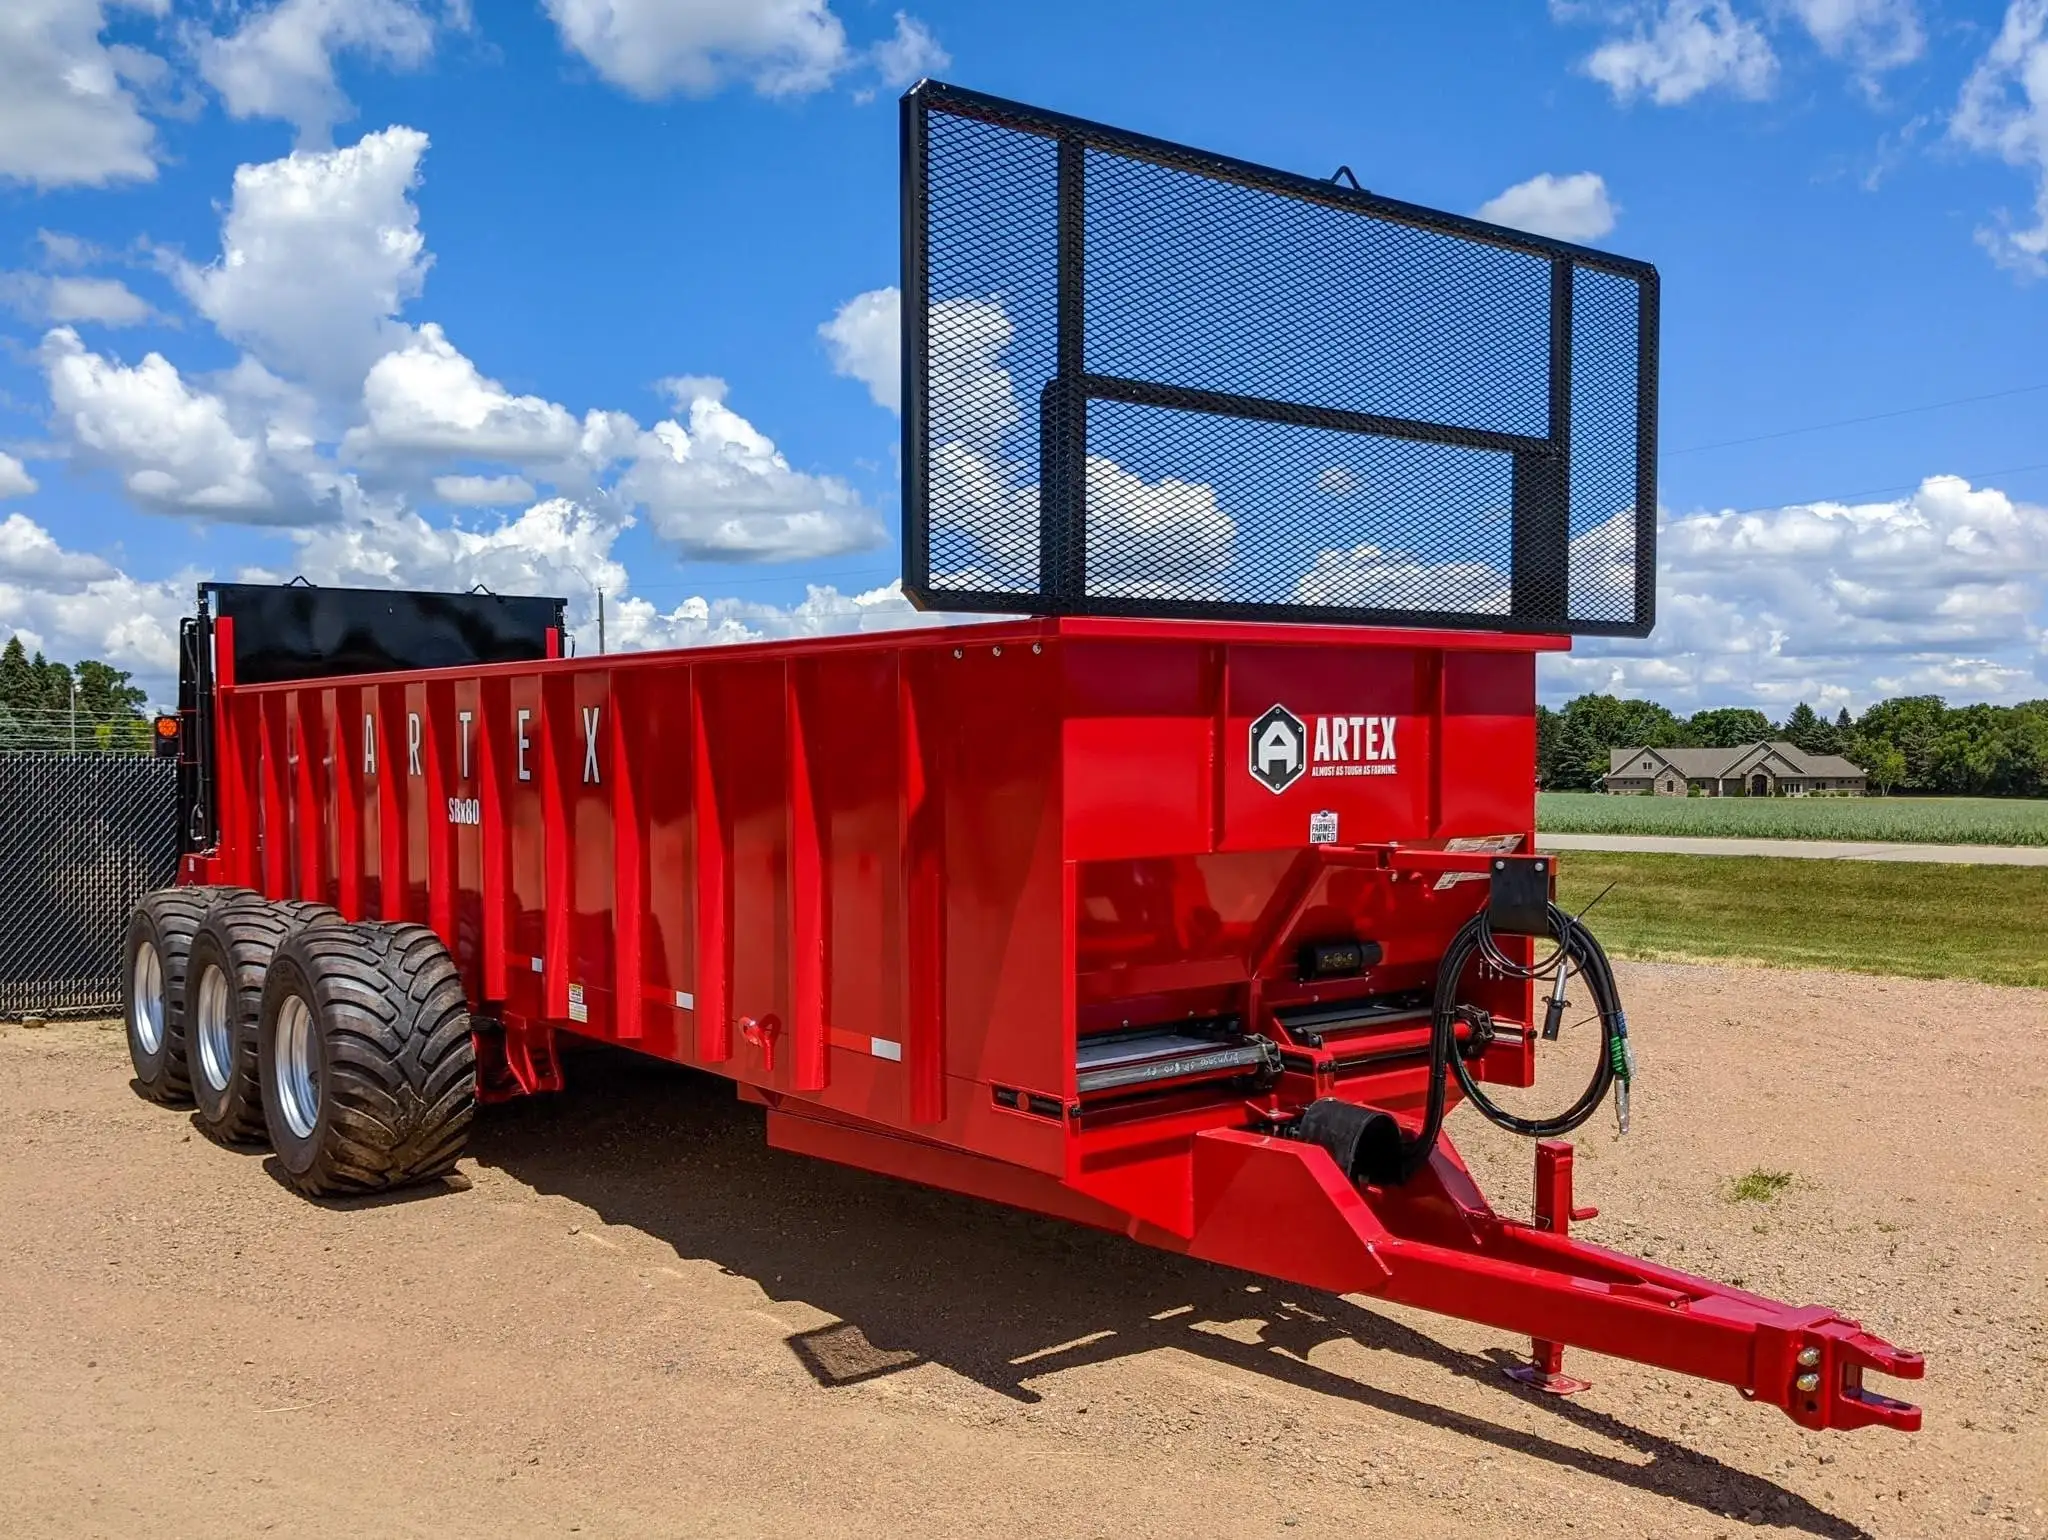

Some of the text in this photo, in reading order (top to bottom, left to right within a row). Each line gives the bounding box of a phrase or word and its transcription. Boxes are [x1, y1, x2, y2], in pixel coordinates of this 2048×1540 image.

[364, 707, 600, 783] ARTEX
[1313, 717, 1397, 762] ARTEX
[1312, 766, 1335, 777] ALMOST
[1335, 766, 1344, 776] AS
[1344, 765, 1363, 776] TOUGH
[1363, 765, 1371, 775] AS
[1312, 824, 1335, 833] FARMER
[1312, 833, 1335, 843] OWNED
